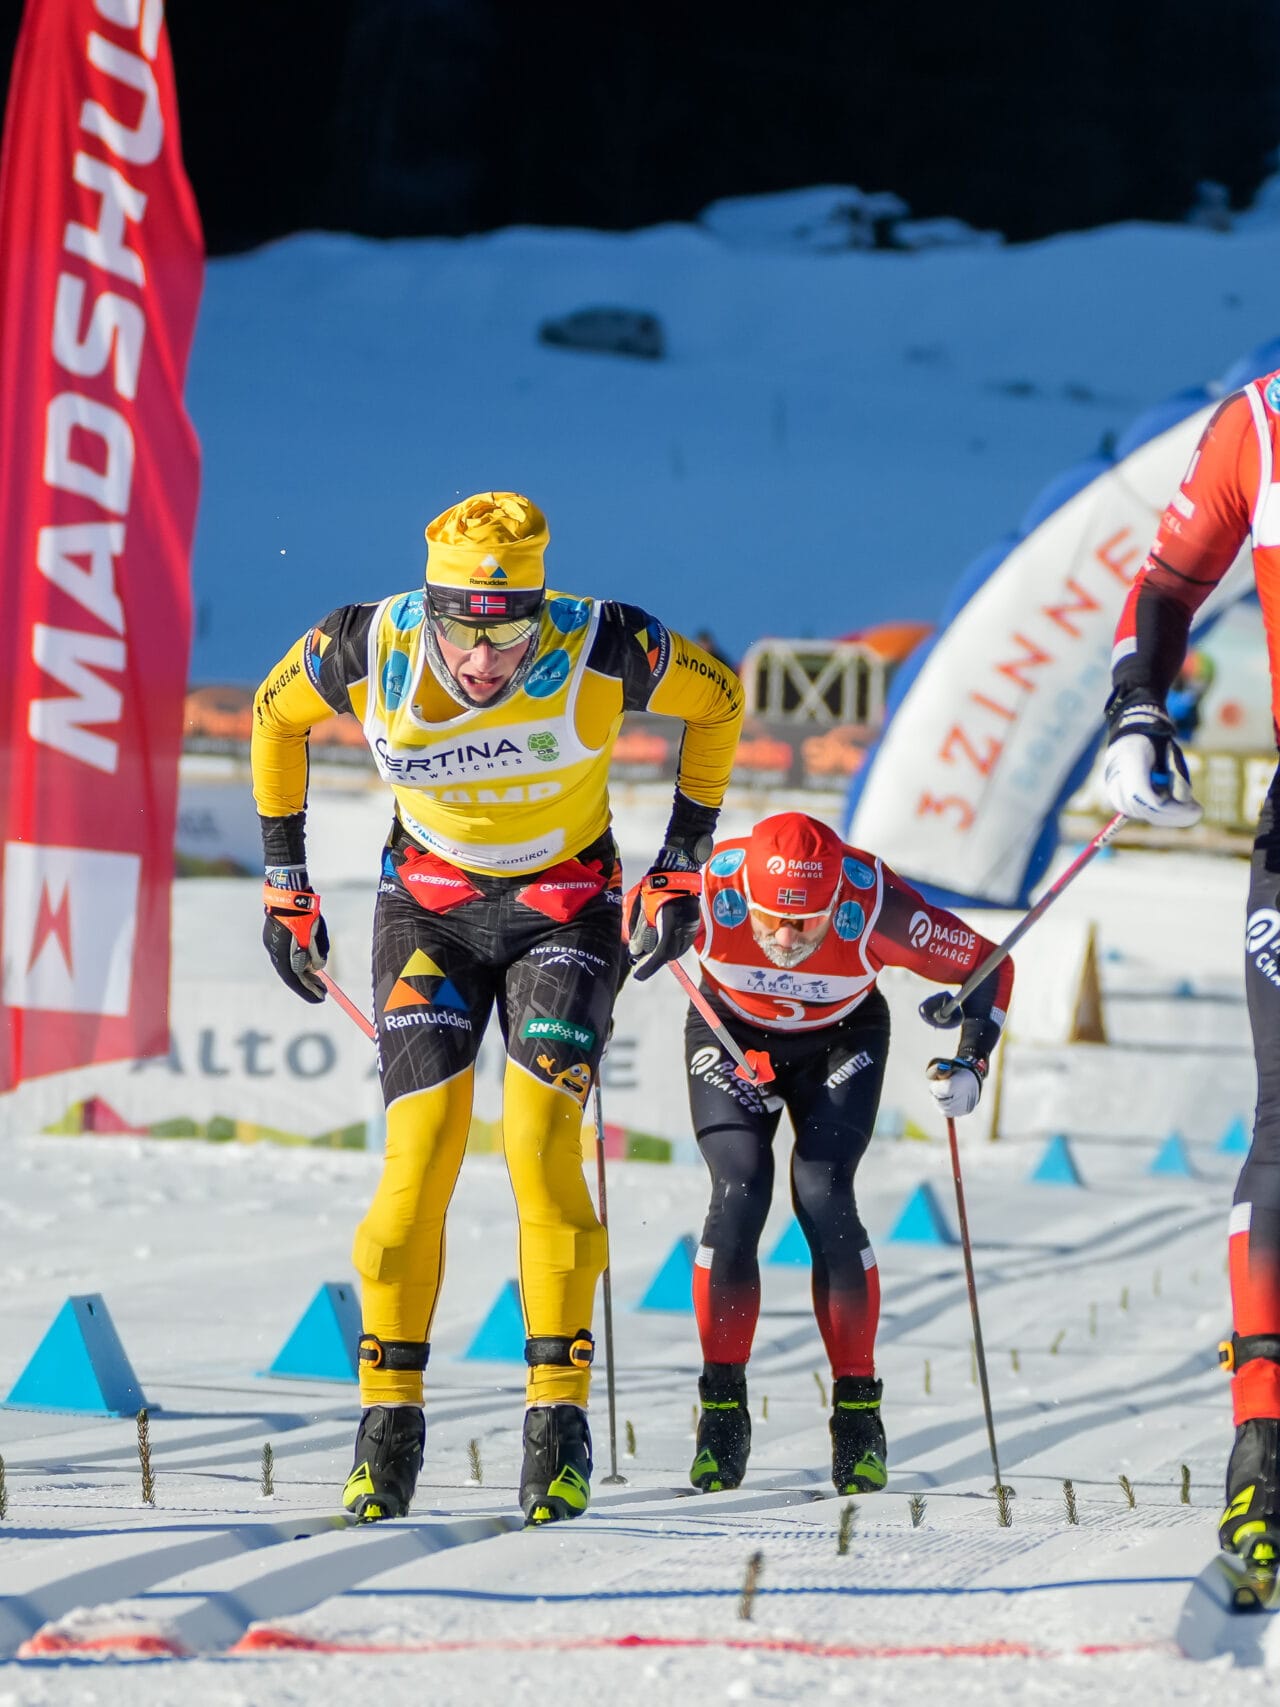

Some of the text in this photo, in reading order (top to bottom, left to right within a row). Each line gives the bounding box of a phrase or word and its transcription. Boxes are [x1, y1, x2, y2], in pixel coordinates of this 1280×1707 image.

[938, 526, 1140, 779] ZINNE
[375, 737, 523, 773] CERTINA
[429, 758, 523, 780] WATCHES
[917, 790, 977, 832] 3
[786, 870, 824, 879] CHARGE
[787, 859, 824, 872] RAGDE
[421, 874, 463, 889] ENERVIT
[933, 924, 976, 950] RAGDE
[529, 945, 610, 968] SWEDEMOUNT
[929, 942, 972, 966] CHARGE
[384, 1009, 472, 1032] Ramudden
[772, 999, 806, 1022] 3
[823, 1050, 874, 1089] TRIMTEX
